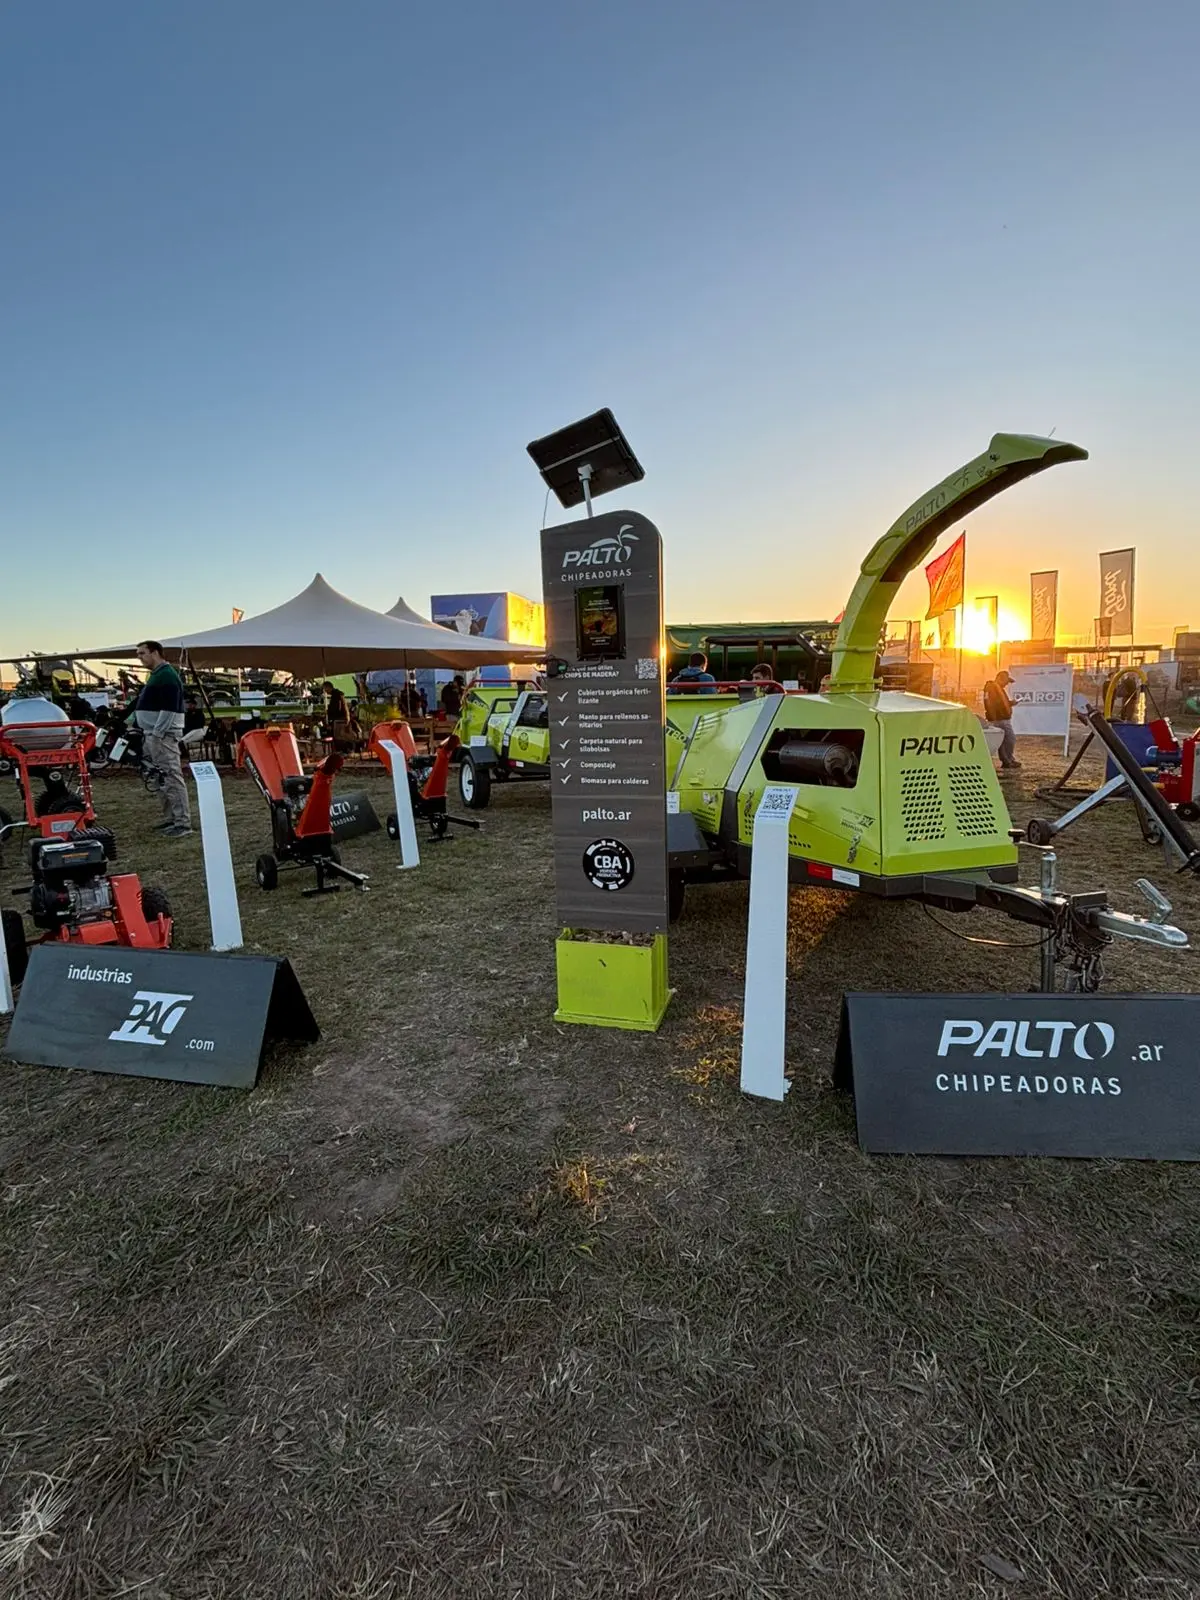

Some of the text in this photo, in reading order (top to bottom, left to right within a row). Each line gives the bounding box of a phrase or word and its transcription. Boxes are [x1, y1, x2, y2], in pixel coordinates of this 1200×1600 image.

[905, 491, 946, 533] PALTO
[562, 546, 632, 568] PALTO
[561, 568, 632, 582] CHIPEADORAS
[605, 689, 633, 697] orgánica
[900, 735, 975, 757] PALTO
[580, 761, 616, 769] Compostaje
[582, 807, 632, 822] palto.ar
[594, 855, 622, 869] CBA
[67, 964, 133, 985] industrias
[185, 1037, 215, 1051] .com
[937, 1020, 1164, 1062] PALTO .ar
[936, 1073, 1122, 1096] CHIPEADORAS
